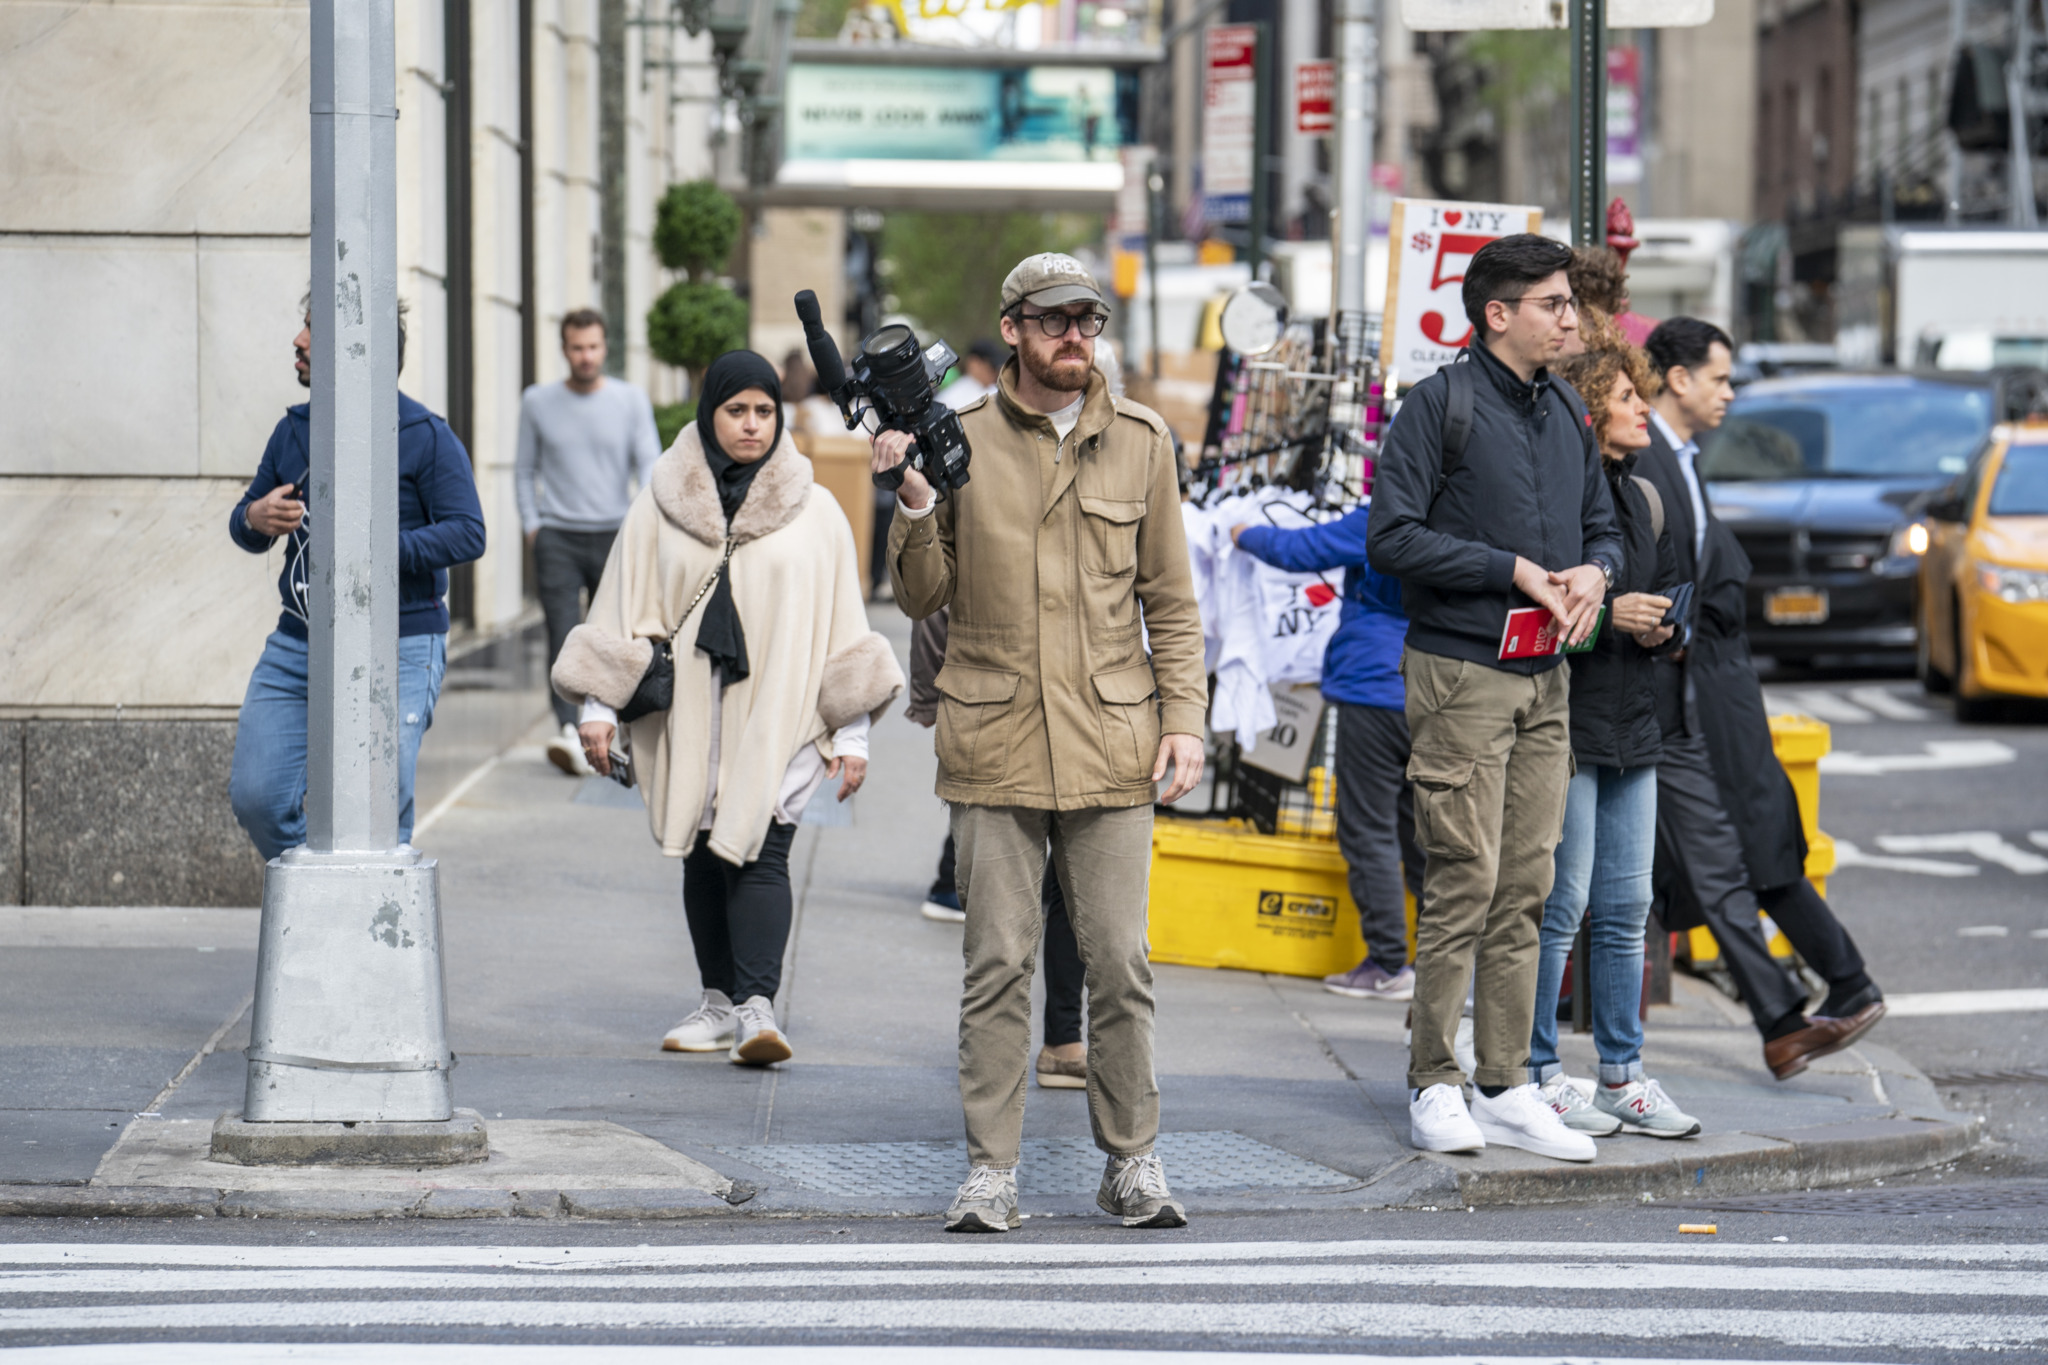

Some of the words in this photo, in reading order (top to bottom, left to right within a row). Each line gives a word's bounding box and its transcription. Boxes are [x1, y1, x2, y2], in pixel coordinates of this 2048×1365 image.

[1430, 208, 1440, 227] I
[1466, 211, 1507, 231] NY
[1273, 608, 1330, 637] NY
[1533, 626, 1547, 652] 2010
